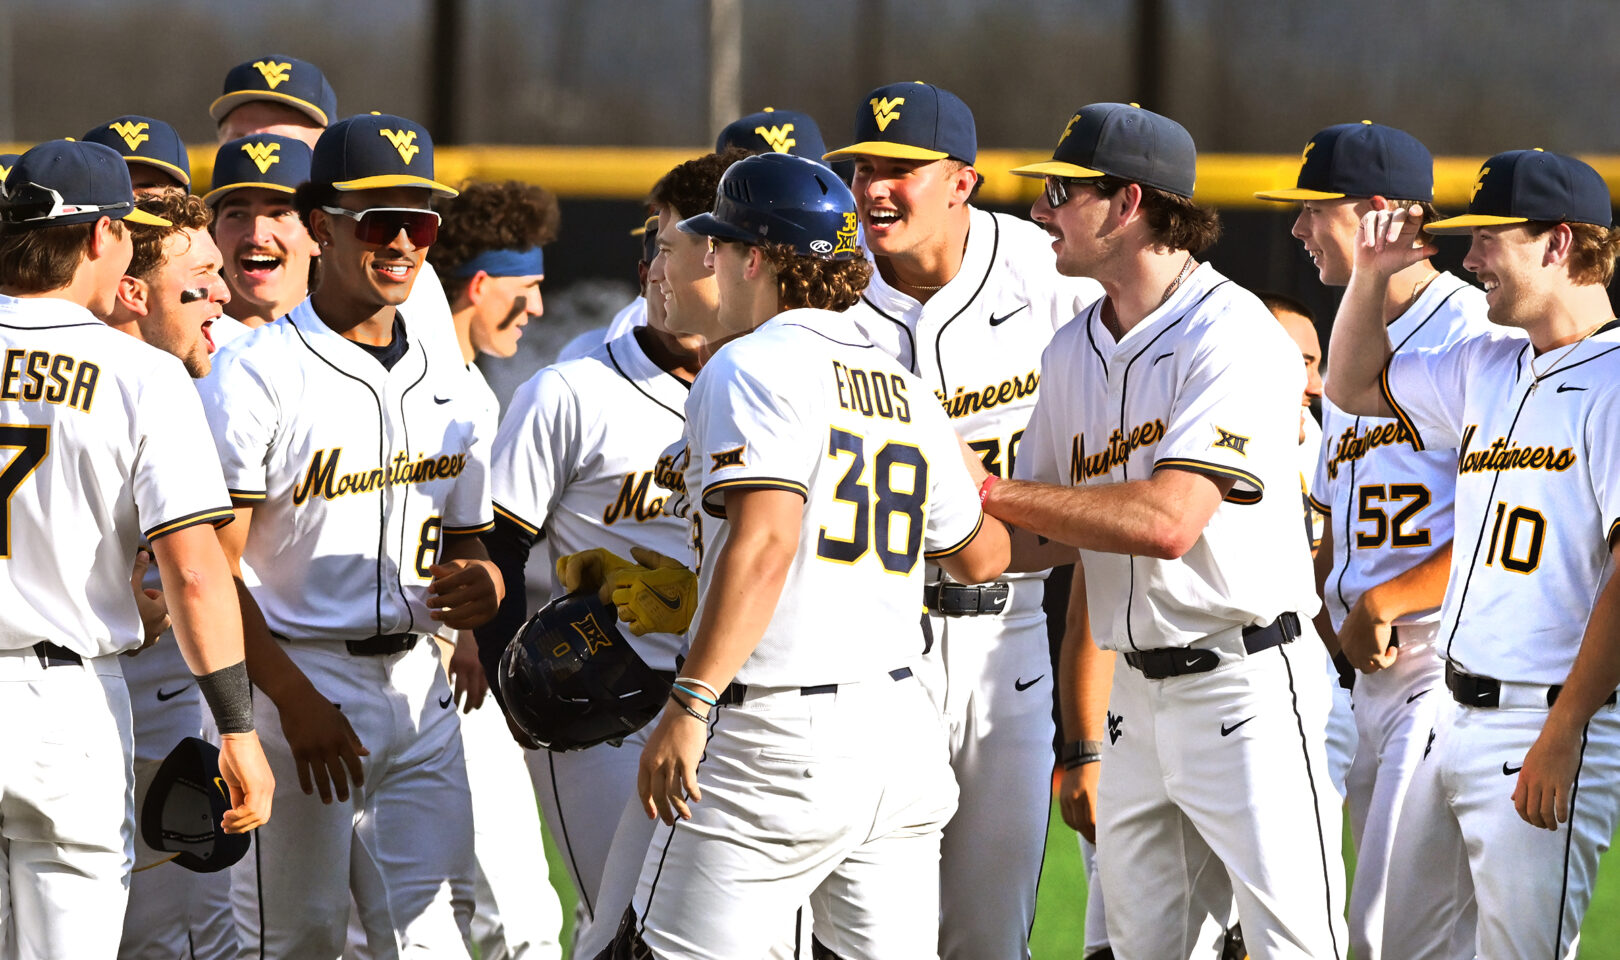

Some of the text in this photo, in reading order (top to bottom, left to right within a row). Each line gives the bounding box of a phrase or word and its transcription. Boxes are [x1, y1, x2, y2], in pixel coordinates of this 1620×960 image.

[843, 212, 857, 232] 38
[1, 348, 101, 414] ESSA
[816, 424, 931, 577] 38
[1356, 482, 1432, 550] 52
[413, 515, 443, 581] 8
[1485, 500, 1548, 576] 10
